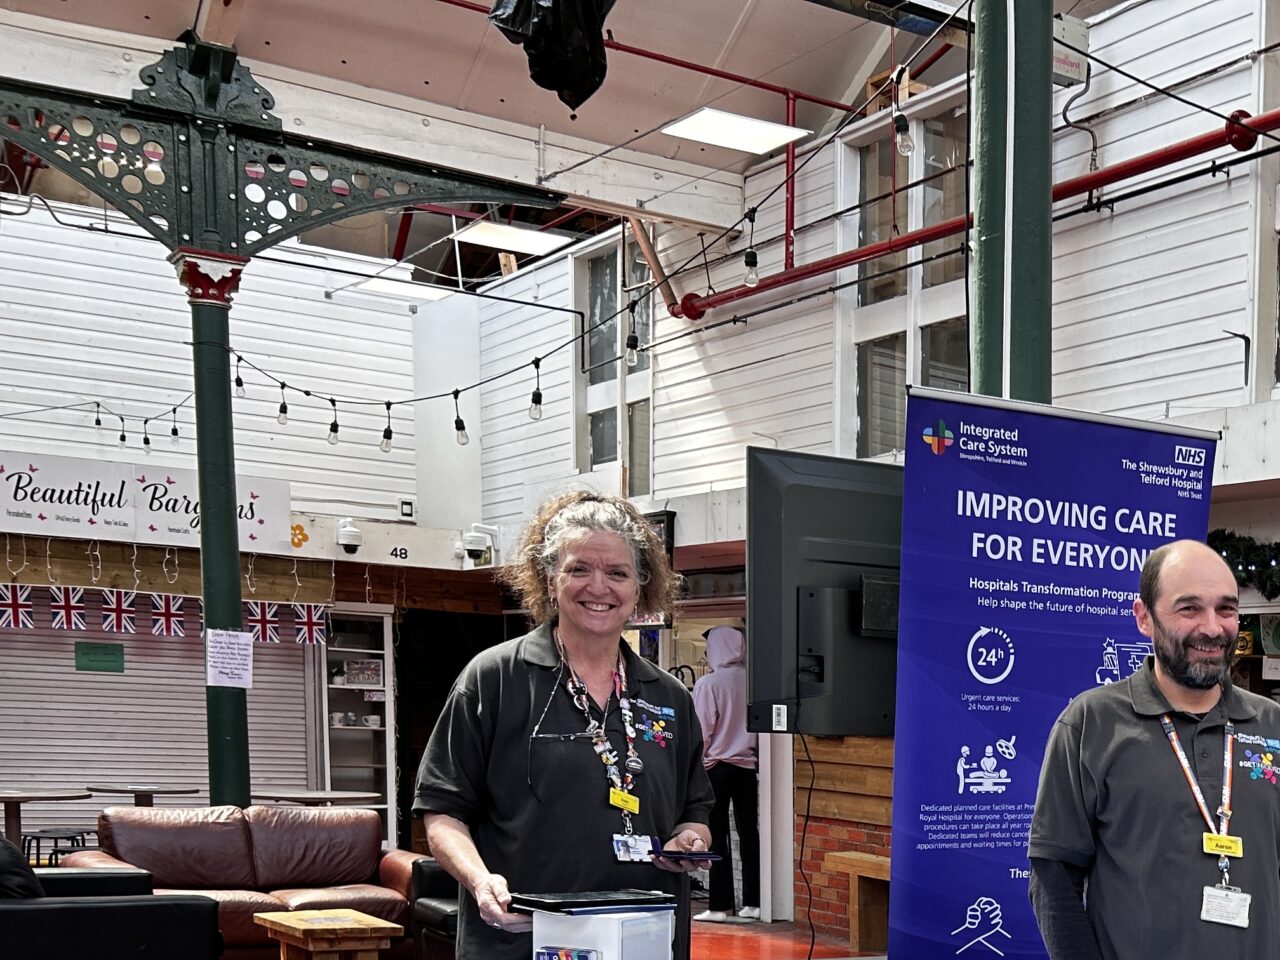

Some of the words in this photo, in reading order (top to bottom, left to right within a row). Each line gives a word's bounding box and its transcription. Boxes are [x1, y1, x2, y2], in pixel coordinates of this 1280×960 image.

[960, 422, 1018, 441] Integrated
[960, 438, 985, 452] Care
[988, 440, 1028, 457] System
[986, 455, 1001, 463] Telford
[1175, 447, 1205, 465] NHS
[1122, 459, 1136, 471] The
[1139, 461, 1187, 478] Shrewsbury
[1189, 468, 1203, 478] and
[1140, 474, 1169, 486] Telford
[1172, 476, 1203, 490] Hospital
[5, 472, 128, 516] Beautiful
[1177, 490, 1190, 499] NHS
[1191, 492, 1203, 500] Trust
[957, 490, 1107, 530] IMPROVING
[1115, 509, 1177, 537] CARE
[390, 547, 408, 560] 48
[972, 532, 1023, 562] FOR
[1031, 538, 1157, 571] EVERYON
[969, 577, 1018, 592] Hospitals
[1021, 581, 1099, 598] Transformation
[977, 596, 998, 610] Help
[1000, 599, 1026, 612] shape
[1029, 599, 1044, 611] the
[1046, 601, 1073, 612] future
[1075, 602, 1085, 613] of
[1087, 602, 1118, 616] hospital
[961, 693, 982, 702] Urgent
[1001, 704, 1011, 712] day
[921, 804, 952, 812] Dedicated
[953, 804, 977, 813] planned
[920, 813, 937, 822] Royal
[938, 813, 962, 822] Hospital
[964, 813, 972, 821] for
[924, 823, 957, 832] procedures
[985, 823, 1000, 832] place
[1010, 823, 1022, 831] year
[928, 832, 959, 840] Dedicated
[917, 841, 959, 850] appointments
[996, 840, 1012, 848] times
[1215, 843, 1232, 851] Aaron
